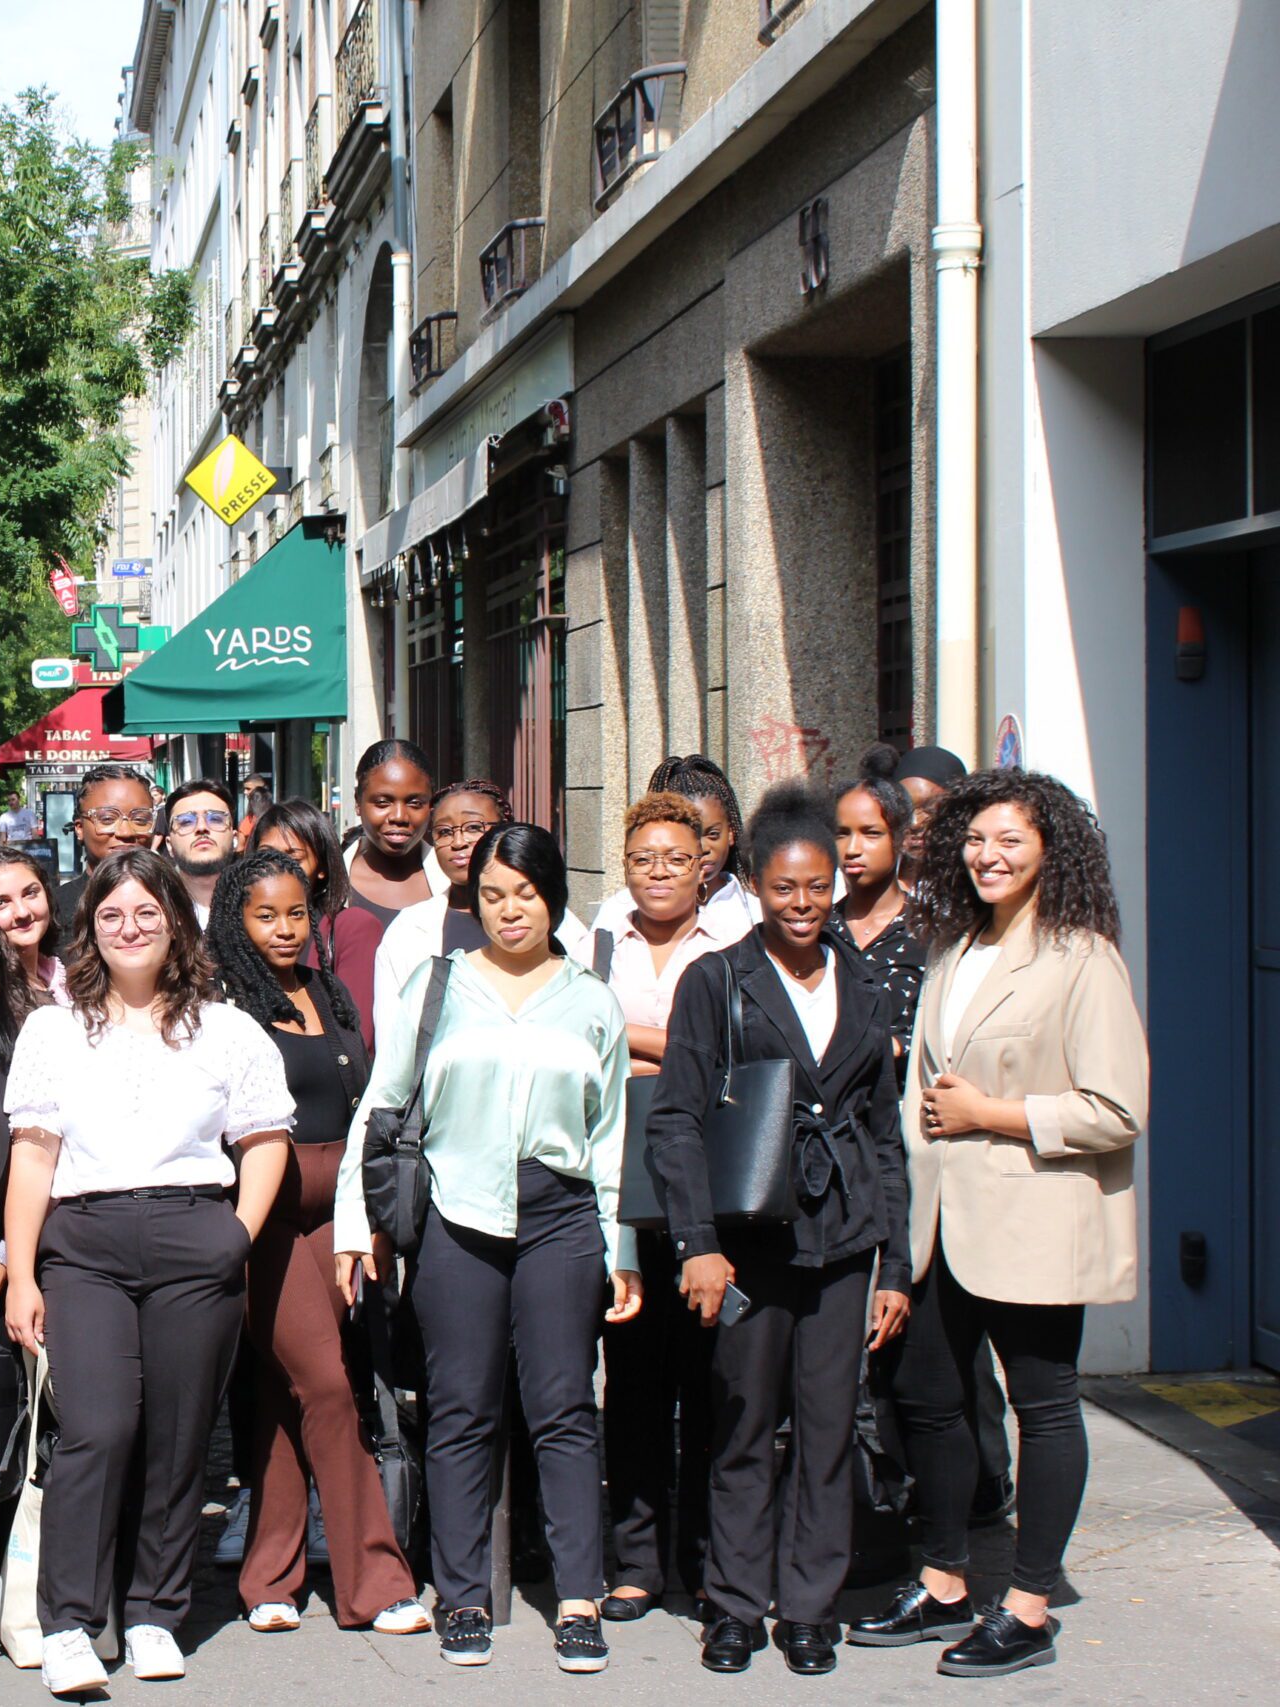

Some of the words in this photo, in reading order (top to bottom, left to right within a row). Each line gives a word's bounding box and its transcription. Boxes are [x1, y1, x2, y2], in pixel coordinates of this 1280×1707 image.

[221, 471, 268, 518] PRESSE
[53, 568, 76, 610] ABAC
[204, 625, 313, 655] YARDS
[45, 729, 91, 742] TABAC
[24, 750, 42, 761] LE
[46, 750, 111, 761] DORIAN
[29, 765, 65, 774] TABAC
